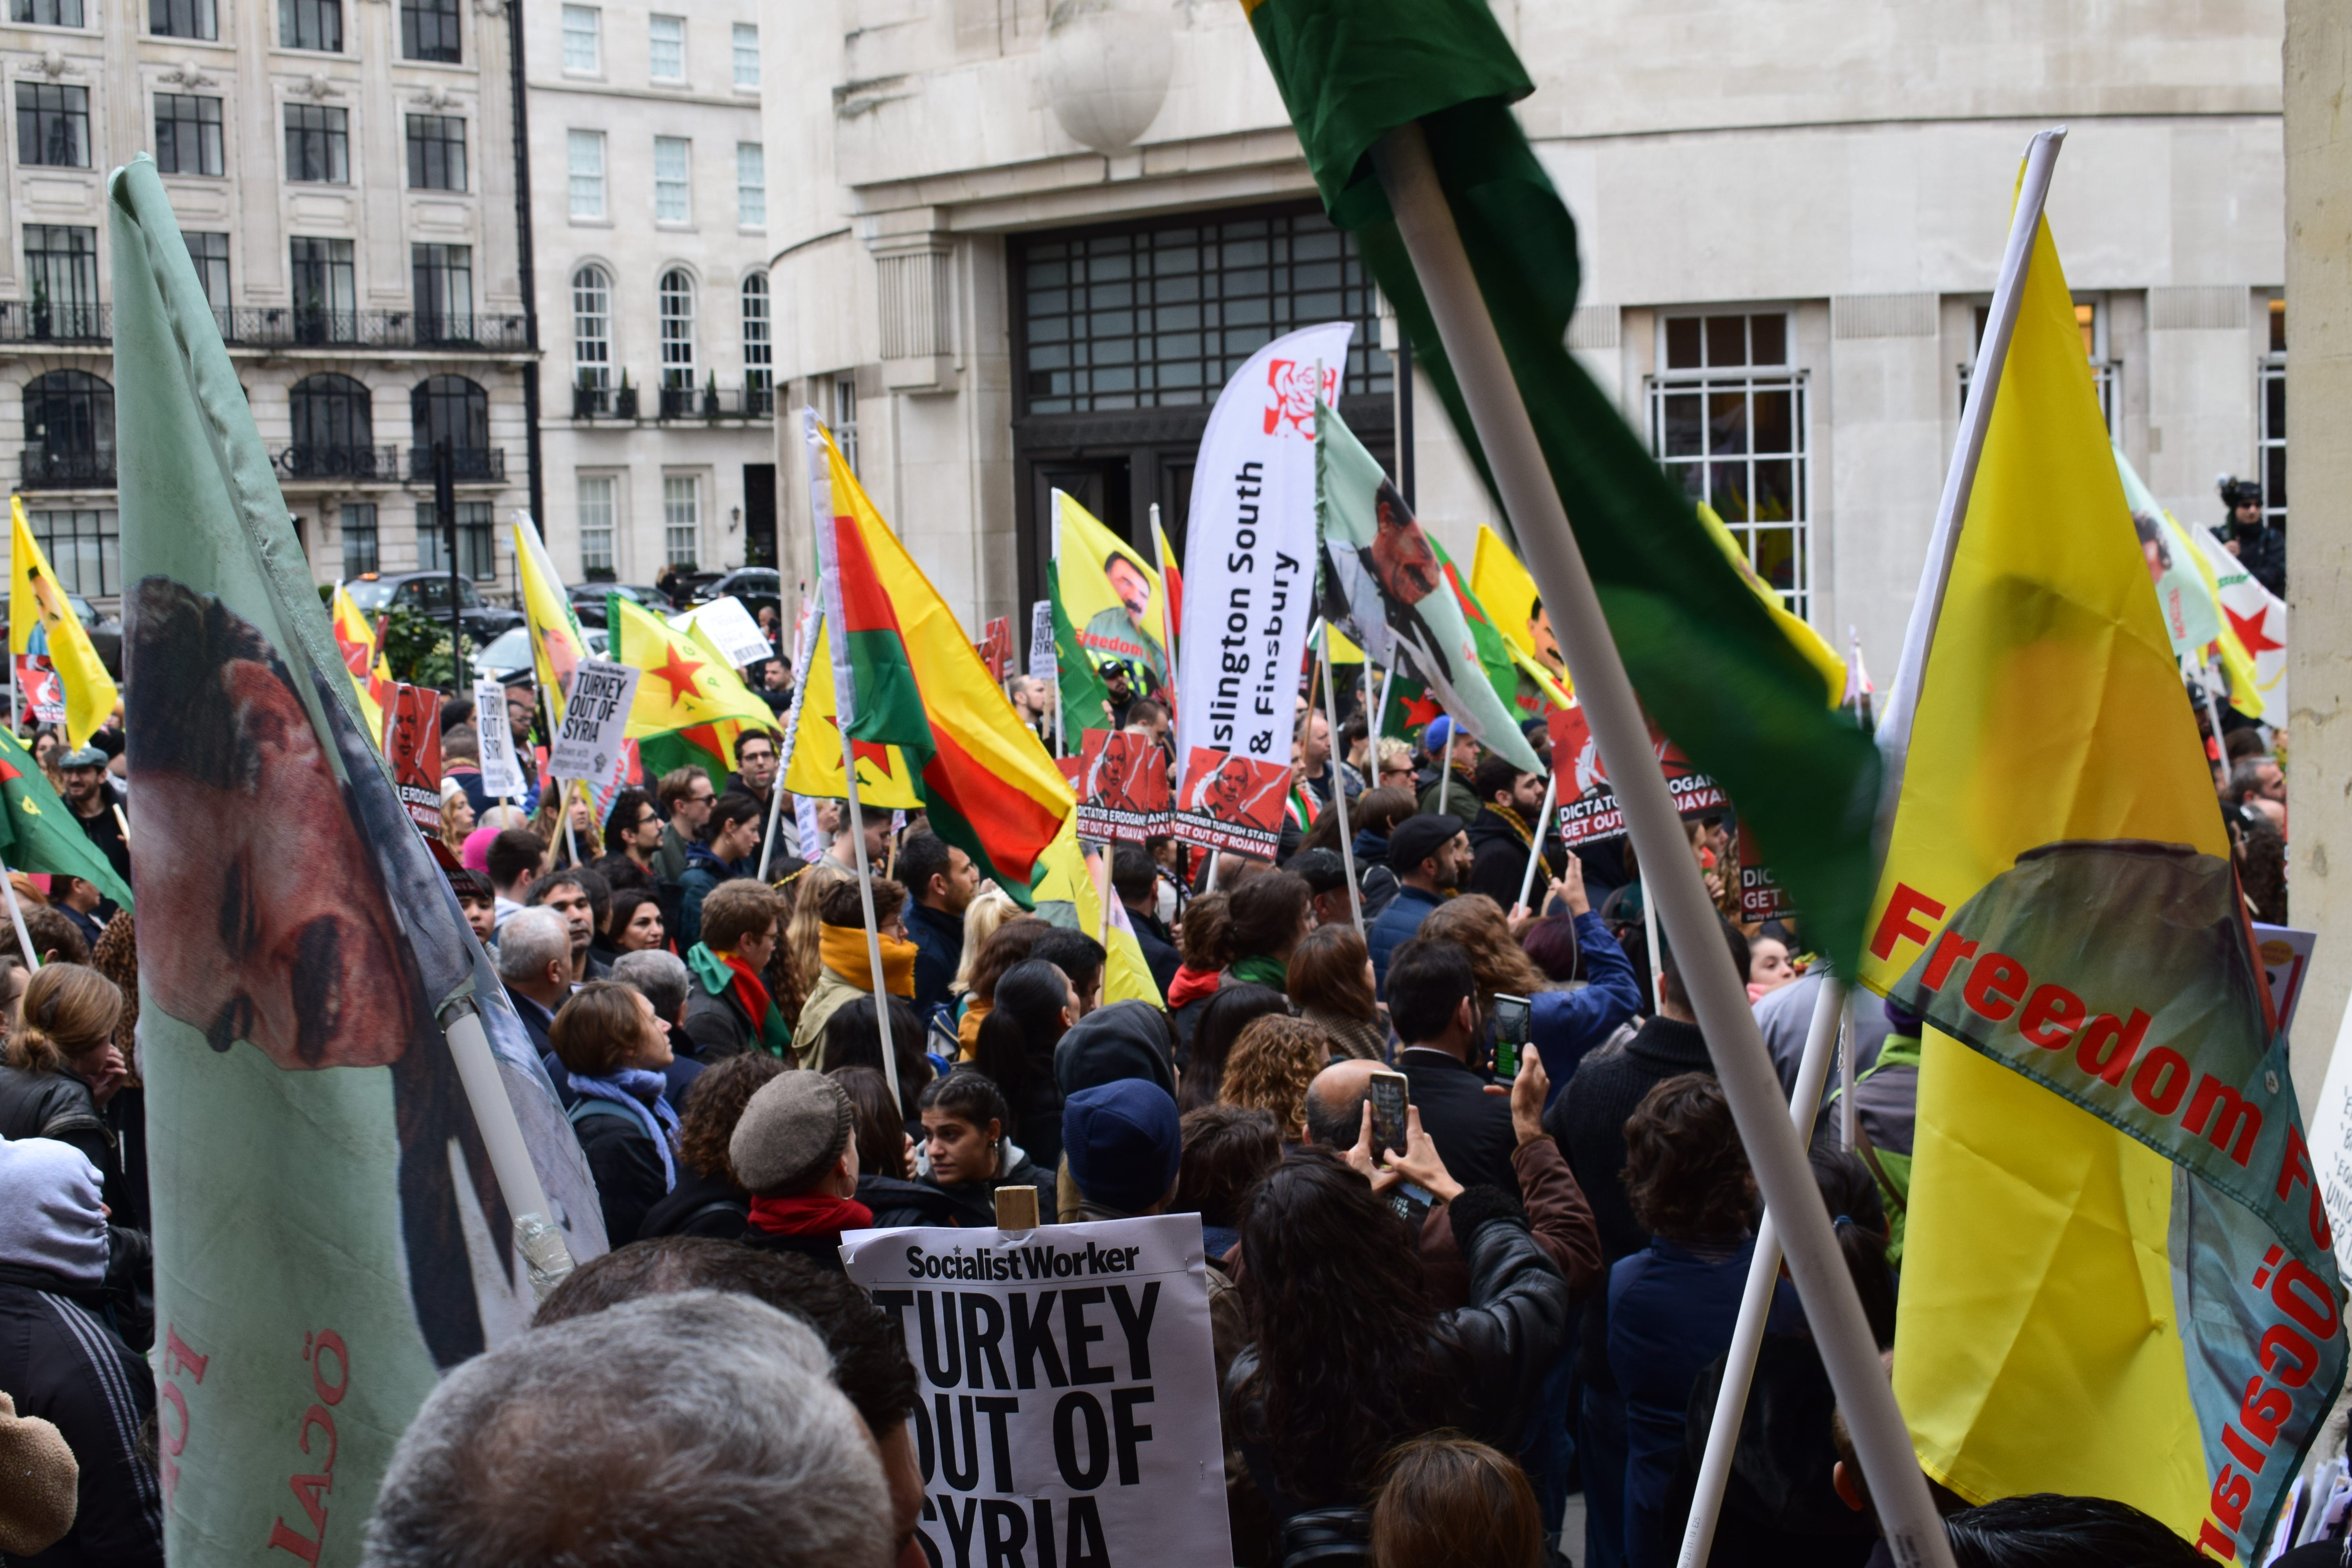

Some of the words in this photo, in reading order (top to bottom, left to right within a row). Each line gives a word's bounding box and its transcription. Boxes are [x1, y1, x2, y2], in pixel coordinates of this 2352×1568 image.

[1227, 461, 1264, 573] South
[1255, 551, 1299, 715] Finsbury
[577, 672, 627, 700] TURKEY
[1209, 588, 1250, 753] Islington
[570, 695, 597, 718] OUT
[598, 700, 618, 722] OF
[563, 718, 600, 742] SYRIA
[1249, 730, 1273, 754] &
[1078, 805, 1108, 820] DICTATOR
[1078, 819, 1089, 831] GET
[1089, 821, 1103, 834] OUT
[1103, 824, 1114, 836] OF
[1176, 811, 1212, 828] MURDERER
[1212, 820, 1246, 835] TURKISH
[1247, 828, 1278, 842] STATE!
[1562, 817, 1590, 838] GET
[1593, 811, 1622, 830] OUT
[1174, 822, 1192, 835] GET
[1192, 827, 1212, 840] OUT
[1212, 833, 1227, 844] OF
[1228, 835, 1275, 856] ROJAVA!
[1744, 888, 1782, 909] GET
[1869, 882, 2263, 1167] Freedom
[906, 1244, 1025, 1281] Socialist
[1021, 1241, 1140, 1279] Worker
[872, 1281, 1161, 1390] TURKEY
[1053, 1386, 1155, 1491] OF
